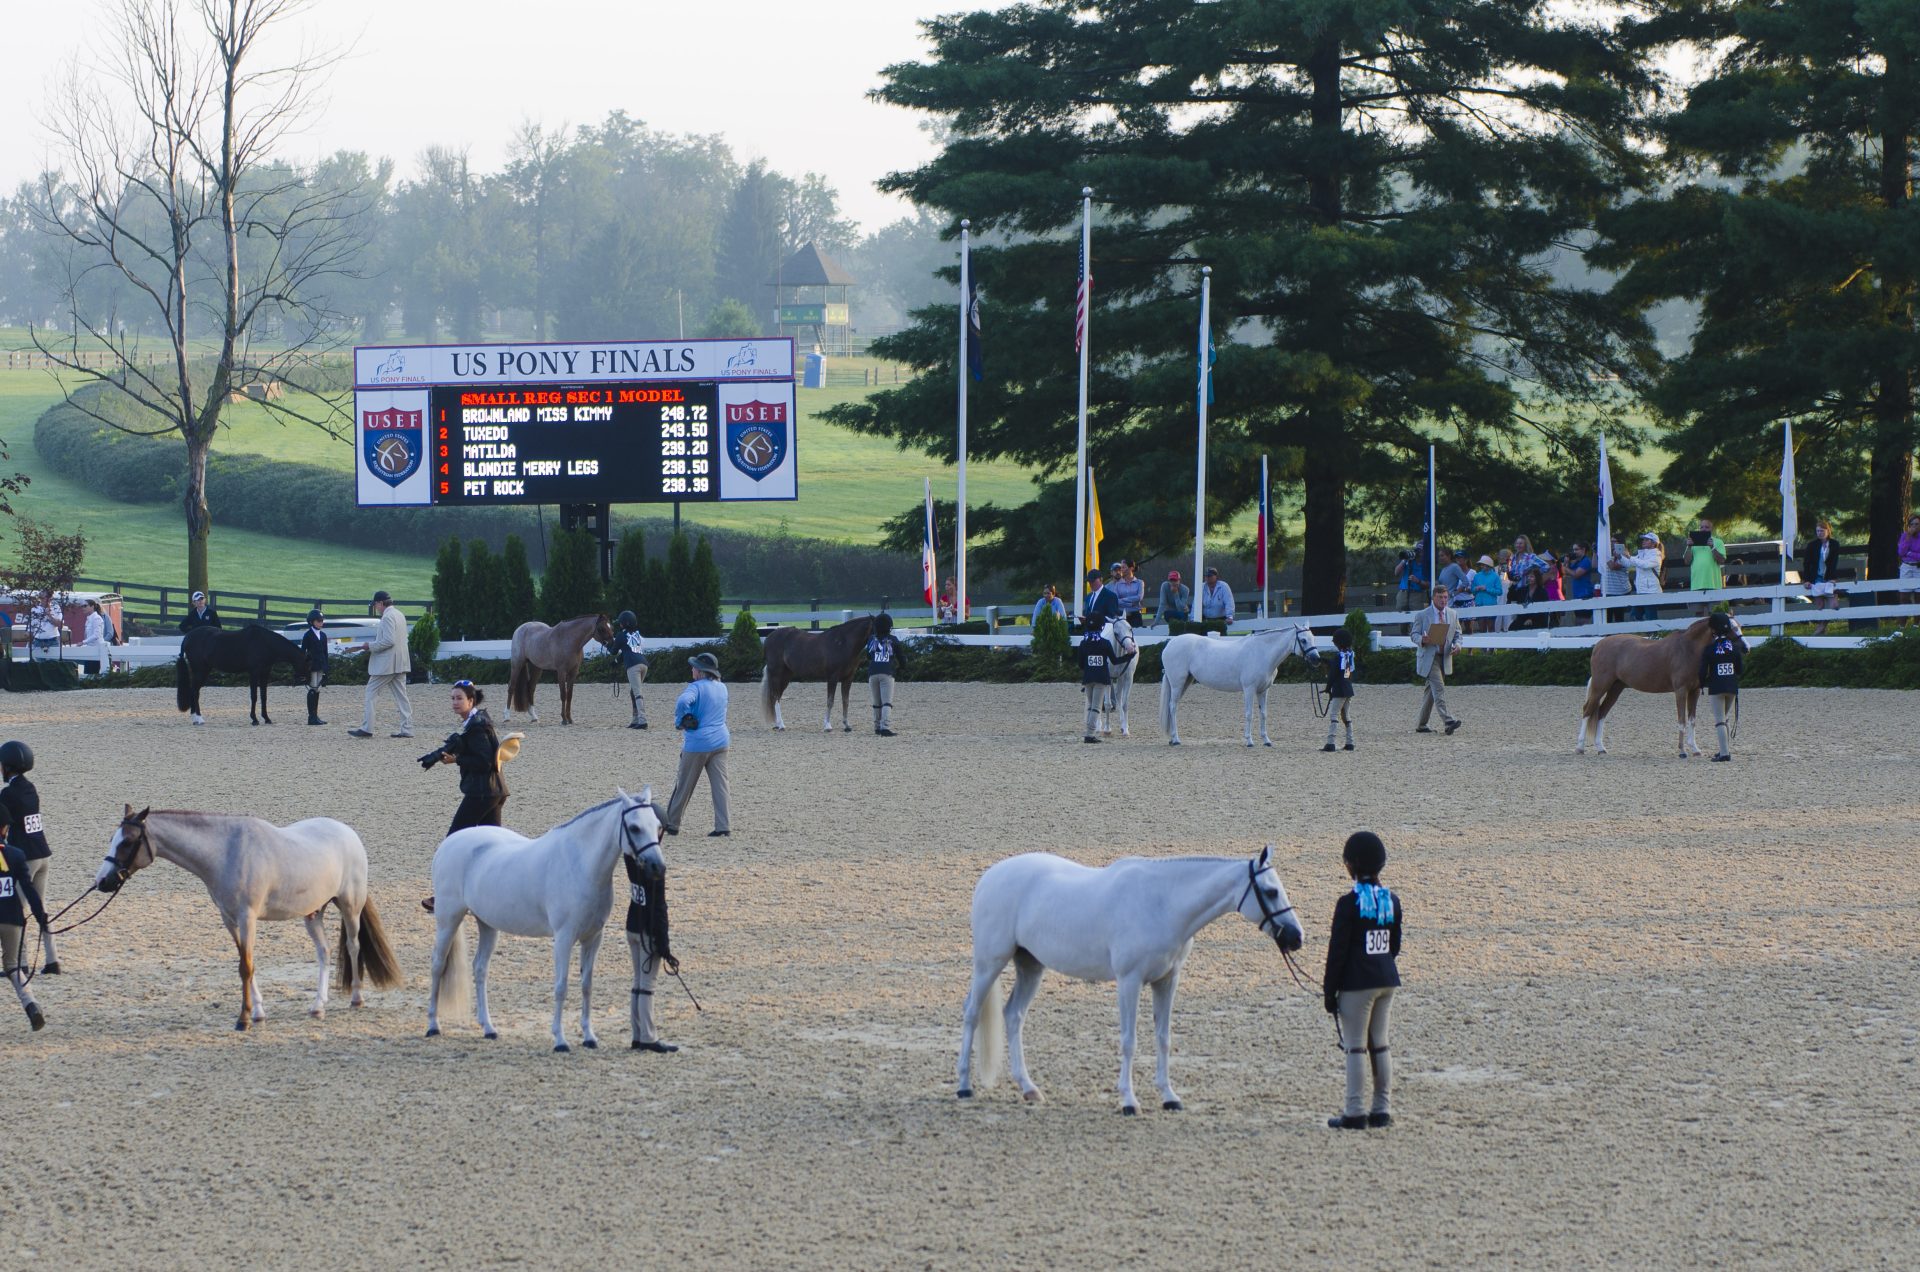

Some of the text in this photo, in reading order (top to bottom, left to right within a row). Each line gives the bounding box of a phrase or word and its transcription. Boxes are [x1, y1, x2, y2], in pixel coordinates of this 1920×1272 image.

[451, 348, 695, 376] US PONY FINALS
[461, 389, 685, 405] SMALL REG SEC 1 MODEL
[367, 413, 418, 428] USEF
[440, 405, 708, 423] 1 BROWNLAND MISS KIMMY 248.72
[730, 406, 782, 421] USEF
[439, 423, 708, 441] 2 TUXEDO 243.50
[440, 440, 709, 459] 3 MATILDA 239.20
[440, 459, 709, 476] 4 BLONDIE MERRY LEGS 238.50
[440, 477, 709, 496] 5 PET ROCK 238.39
[1718, 663, 1733, 674] 556
[25, 814, 41, 832] 563
[1368, 931, 1388, 952] 309
